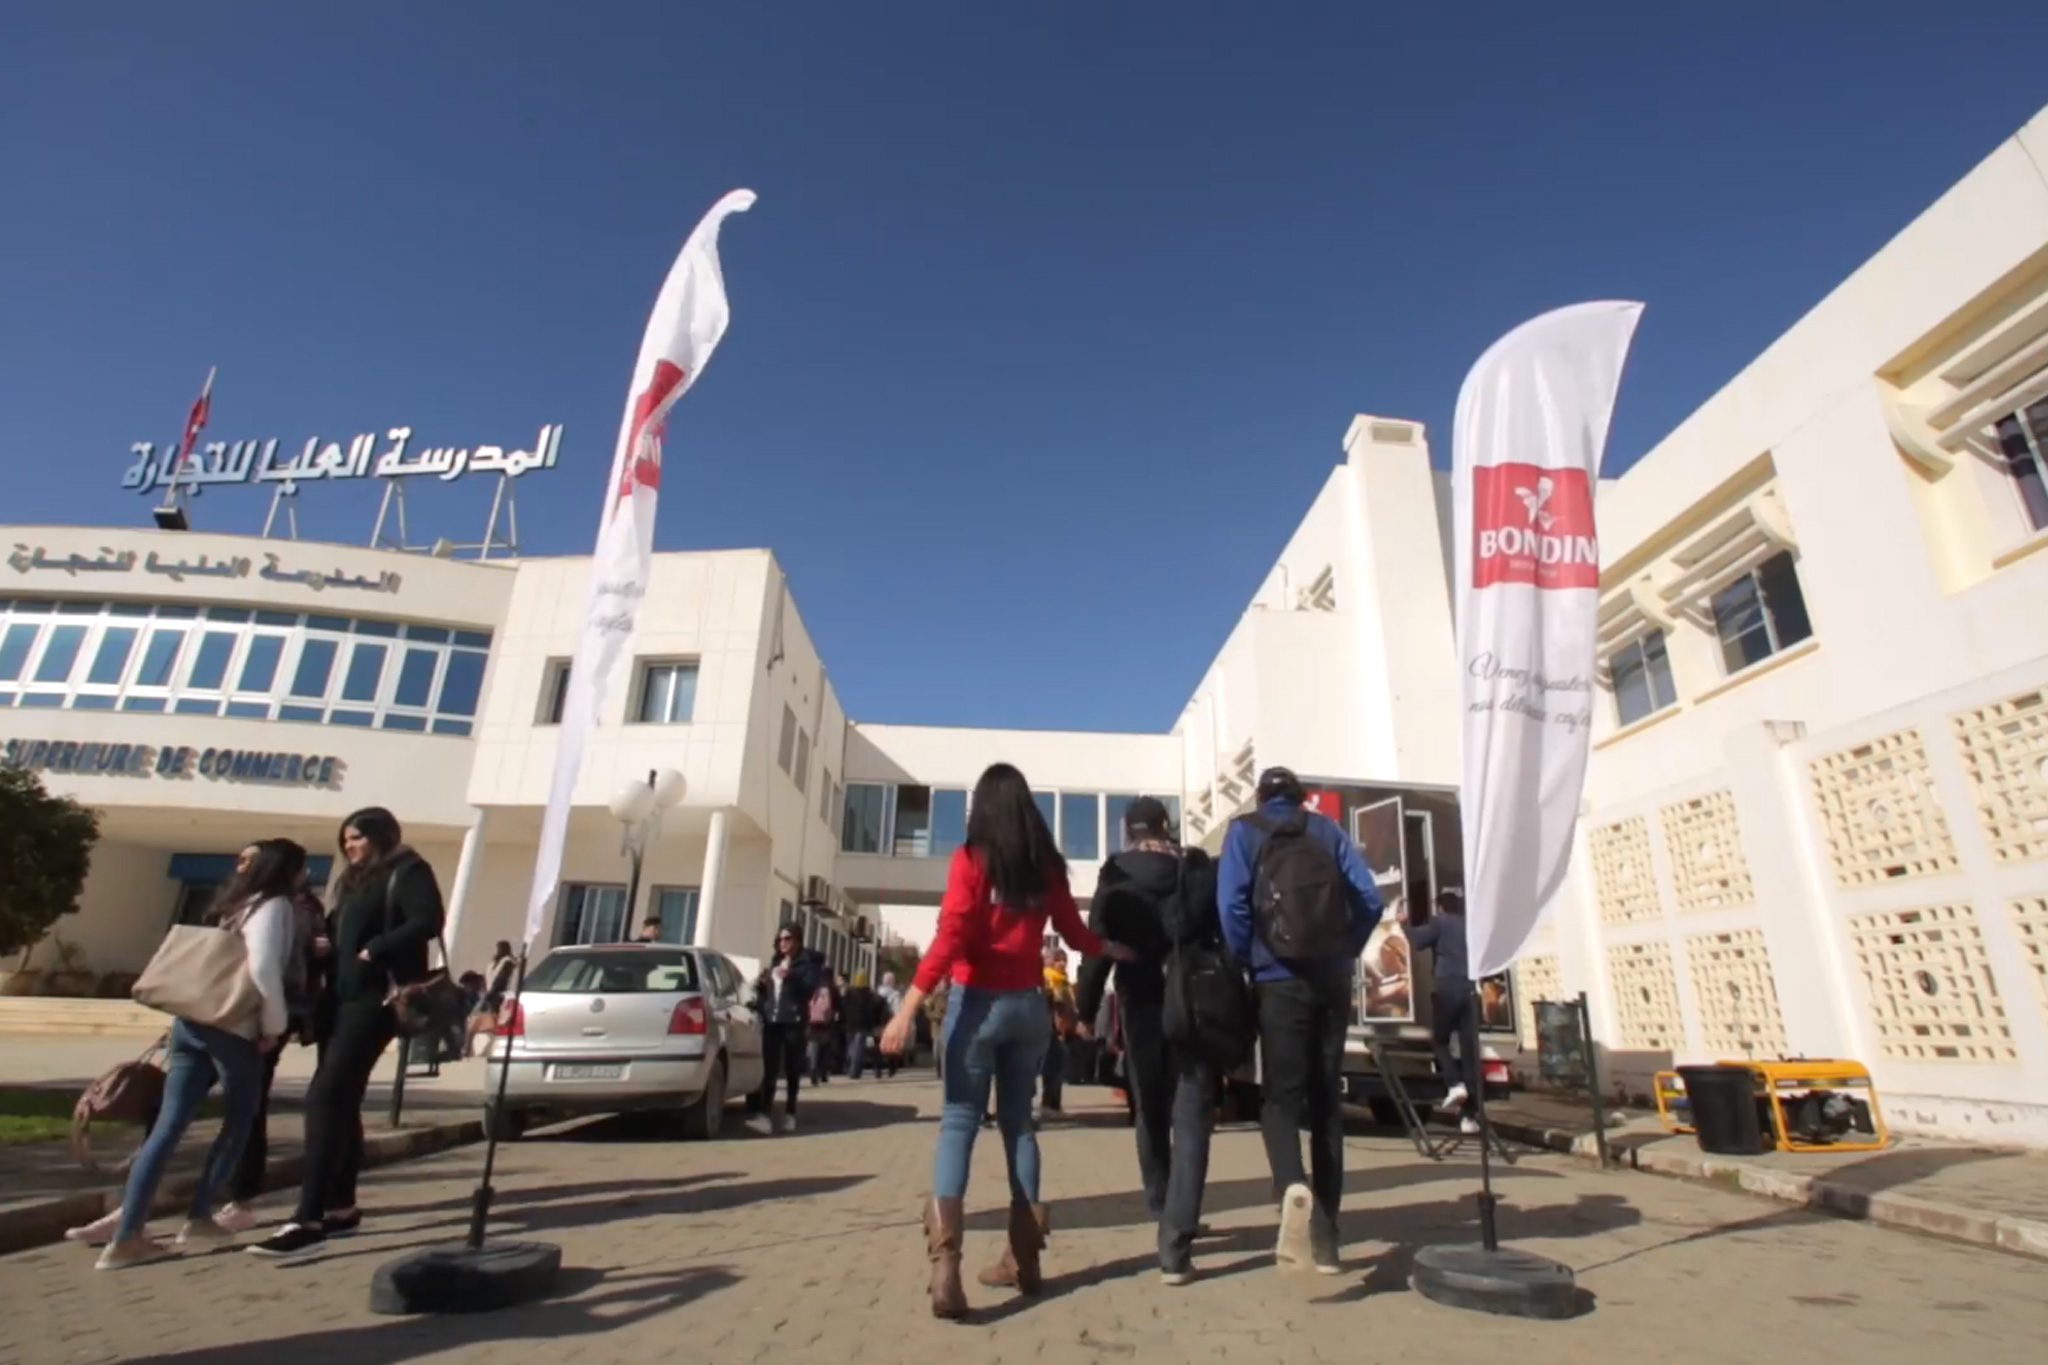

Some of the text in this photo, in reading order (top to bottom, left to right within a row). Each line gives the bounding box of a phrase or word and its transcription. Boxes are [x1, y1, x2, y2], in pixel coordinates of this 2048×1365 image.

[120, 424, 565, 497] المدرسة العليا للتجارة
[155, 746, 194, 777] DE
[199, 748, 343, 788] COMMERCE
